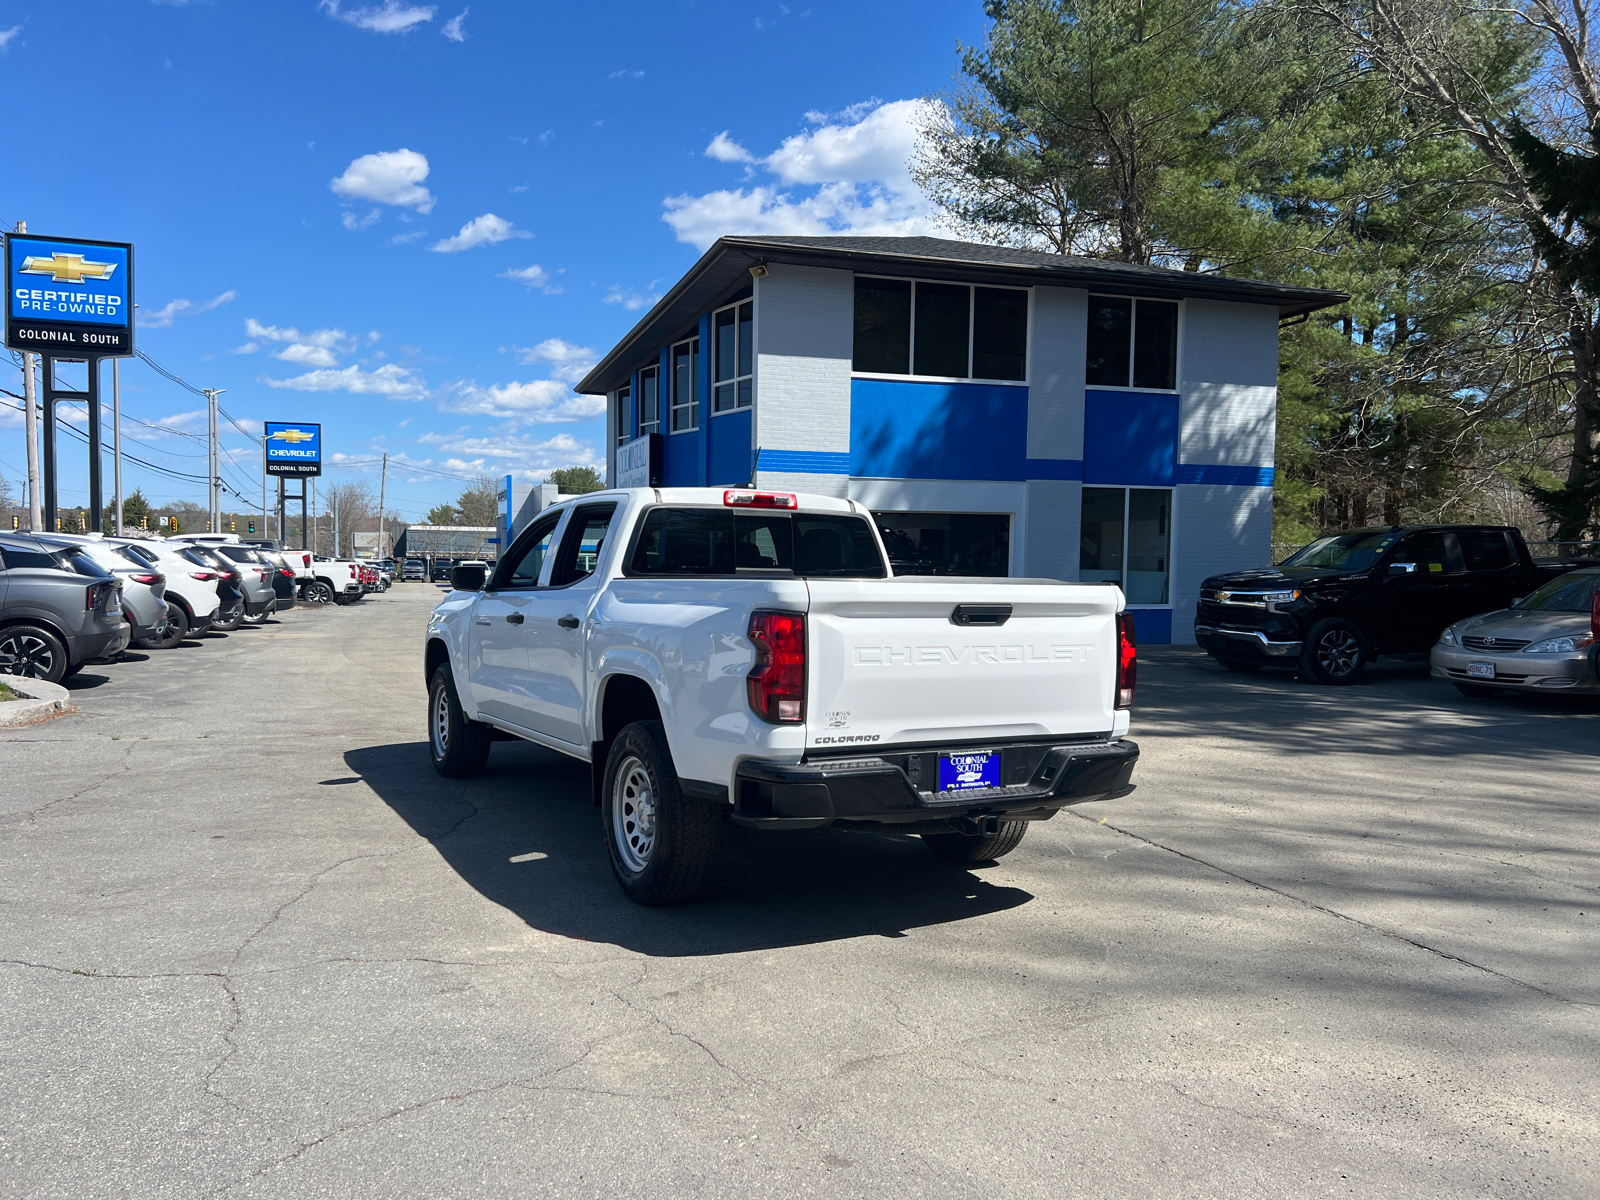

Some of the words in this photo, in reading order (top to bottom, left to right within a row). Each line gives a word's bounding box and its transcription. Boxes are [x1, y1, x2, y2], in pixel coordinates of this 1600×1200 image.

[16, 289, 121, 305] CERTIFIED
[22, 300, 116, 315] PRE-OWNED
[19, 329, 76, 342] COLONIAL
[83, 333, 119, 344] SOUTH
[853, 644, 1095, 666] CHEVROLET
[815, 734, 880, 744] COLORADO
[950, 755, 989, 766] COLONIAL
[956, 764, 983, 773] SOUTH
